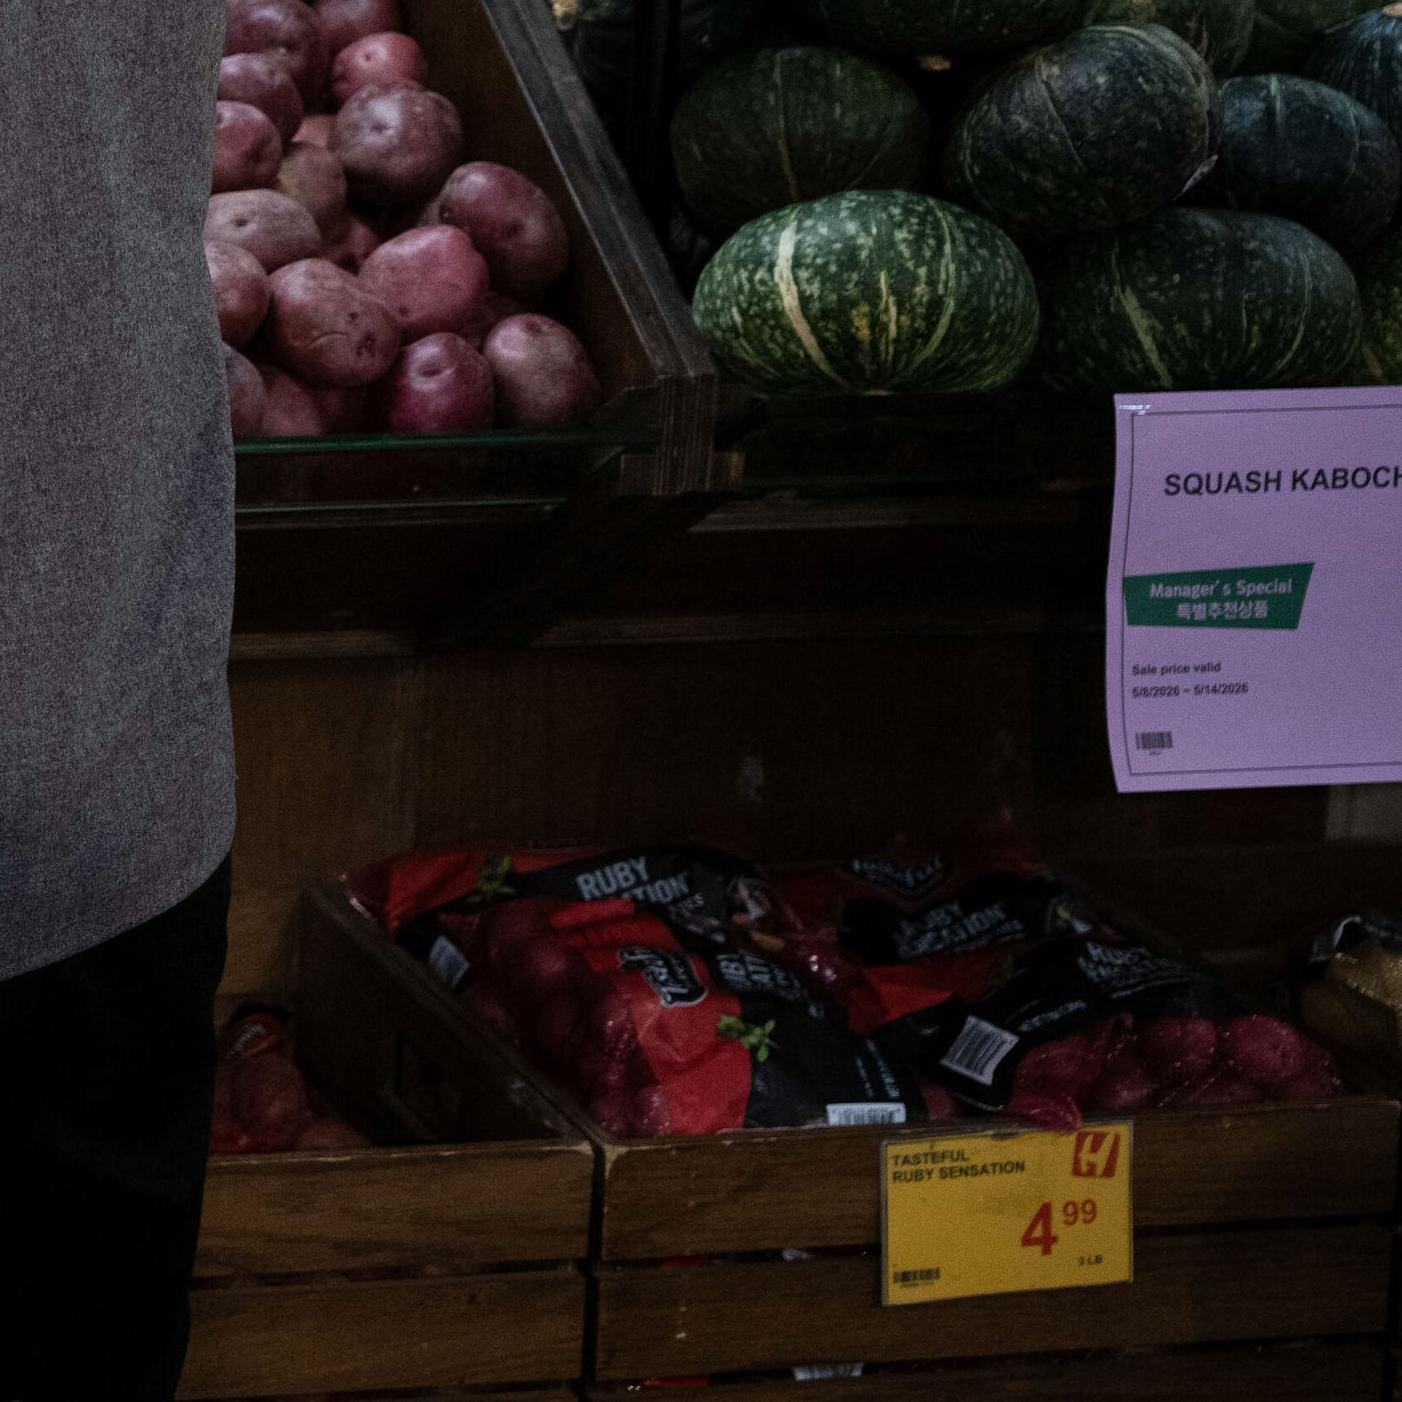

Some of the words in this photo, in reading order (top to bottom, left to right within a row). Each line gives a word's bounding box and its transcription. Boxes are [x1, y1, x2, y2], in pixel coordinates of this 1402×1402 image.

[1163, 470, 1283, 497] SQUASH
[1236, 578, 1293, 597] Special
[1176, 601, 1270, 620] 특별추천상품
[1132, 664, 1157, 675] Sale
[1161, 663, 1192, 677] price
[1194, 661, 1222, 673] valid
[576, 855, 650, 901] RUBY
[892, 1149, 971, 1166] TASTEFUL
[892, 1168, 935, 1183] RUBY
[939, 1160, 1027, 1180] SENSATION
[1021, 1201, 1059, 1256] 4
[1062, 1200, 1098, 1226] 99
